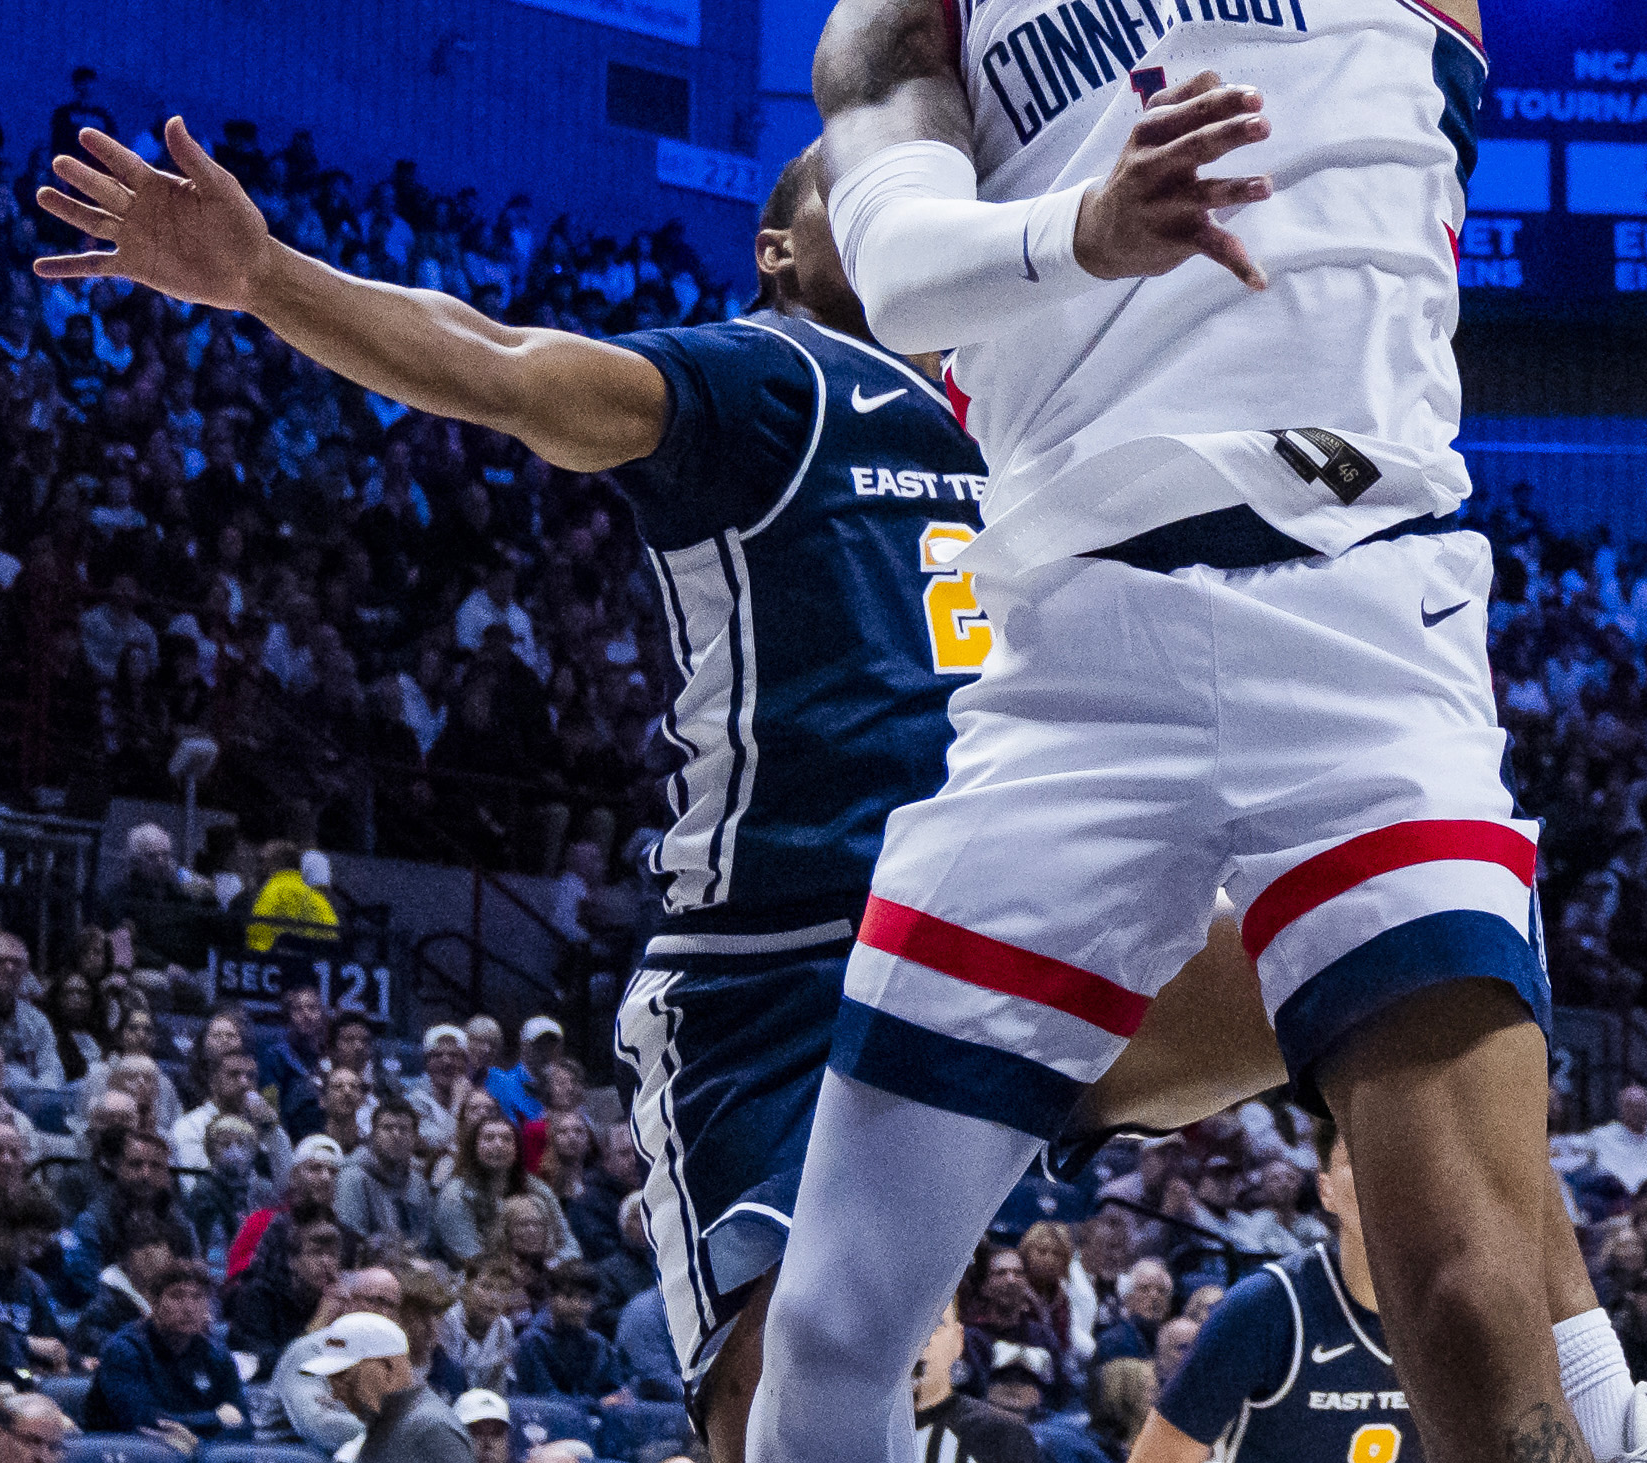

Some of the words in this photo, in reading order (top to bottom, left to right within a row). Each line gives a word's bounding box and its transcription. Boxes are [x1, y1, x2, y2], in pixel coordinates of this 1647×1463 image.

[853, 467, 940, 500] EAST
[220, 958, 283, 995] SEC
[310, 958, 394, 1024] 121
[1307, 1390, 1374, 1411] EAST
